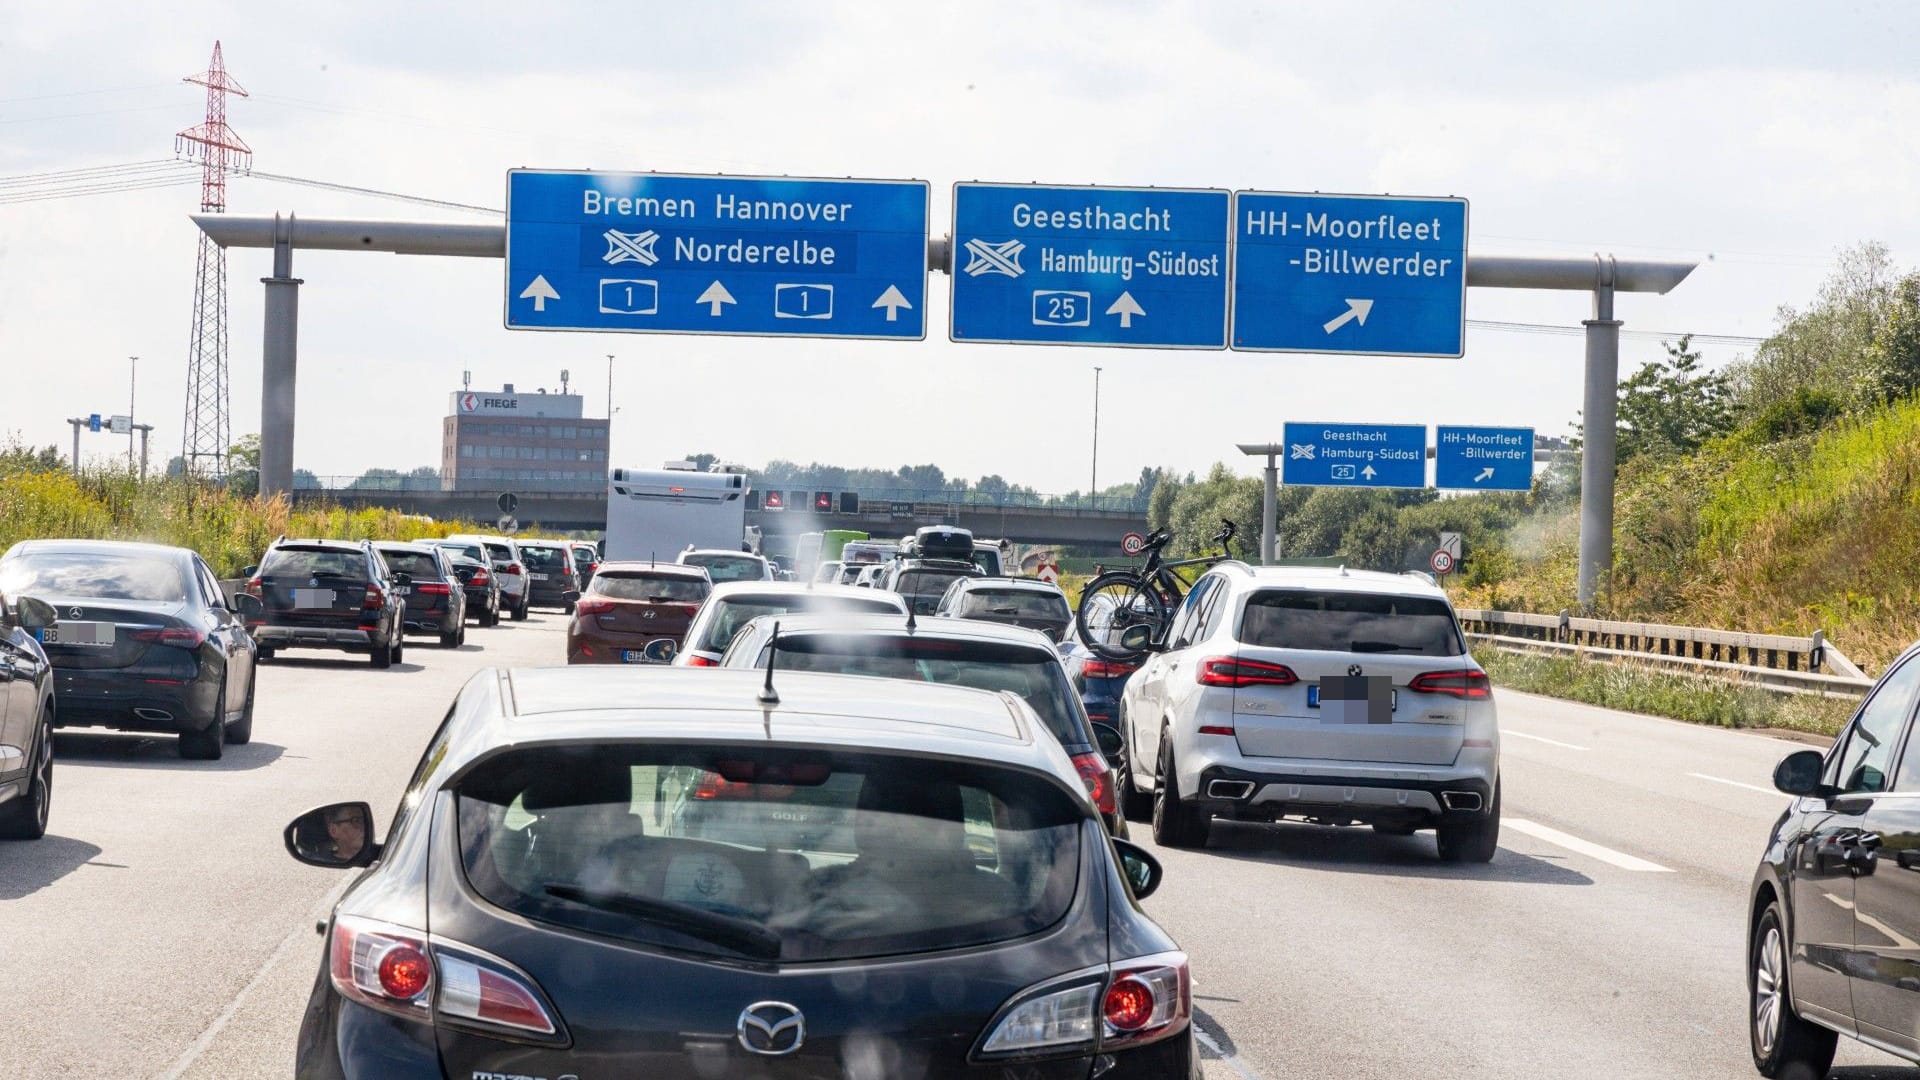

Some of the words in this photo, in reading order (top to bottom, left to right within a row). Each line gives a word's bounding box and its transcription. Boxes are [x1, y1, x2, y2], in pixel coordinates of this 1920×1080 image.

[583, 190, 695, 218] Bremen
[716, 194, 852, 222] Hannover
[1013, 203, 1171, 232] Geesthacht
[1247, 210, 1441, 240] HH-Moorfleet
[675, 236, 835, 265] Norderelbe
[1041, 247, 1219, 281] Hamburg-Südost
[1289, 248, 1452, 277] -Billwerder
[625, 286, 633, 307] 1
[800, 291, 808, 312] 1
[1048, 298, 1075, 319] 25
[484, 398, 518, 409] FIEGE
[1323, 430, 1387, 442] Geesthacht
[1442, 433, 1523, 446] HH-Moorfleet
[1321, 447, 1420, 461] Hamburg-Südost
[1460, 448, 1527, 460] -Billwerder
[1338, 467, 1349, 477] 25
[1127, 539, 1139, 549] 60
[1437, 556, 1449, 567] 60
[44, 630, 58, 642] BB
